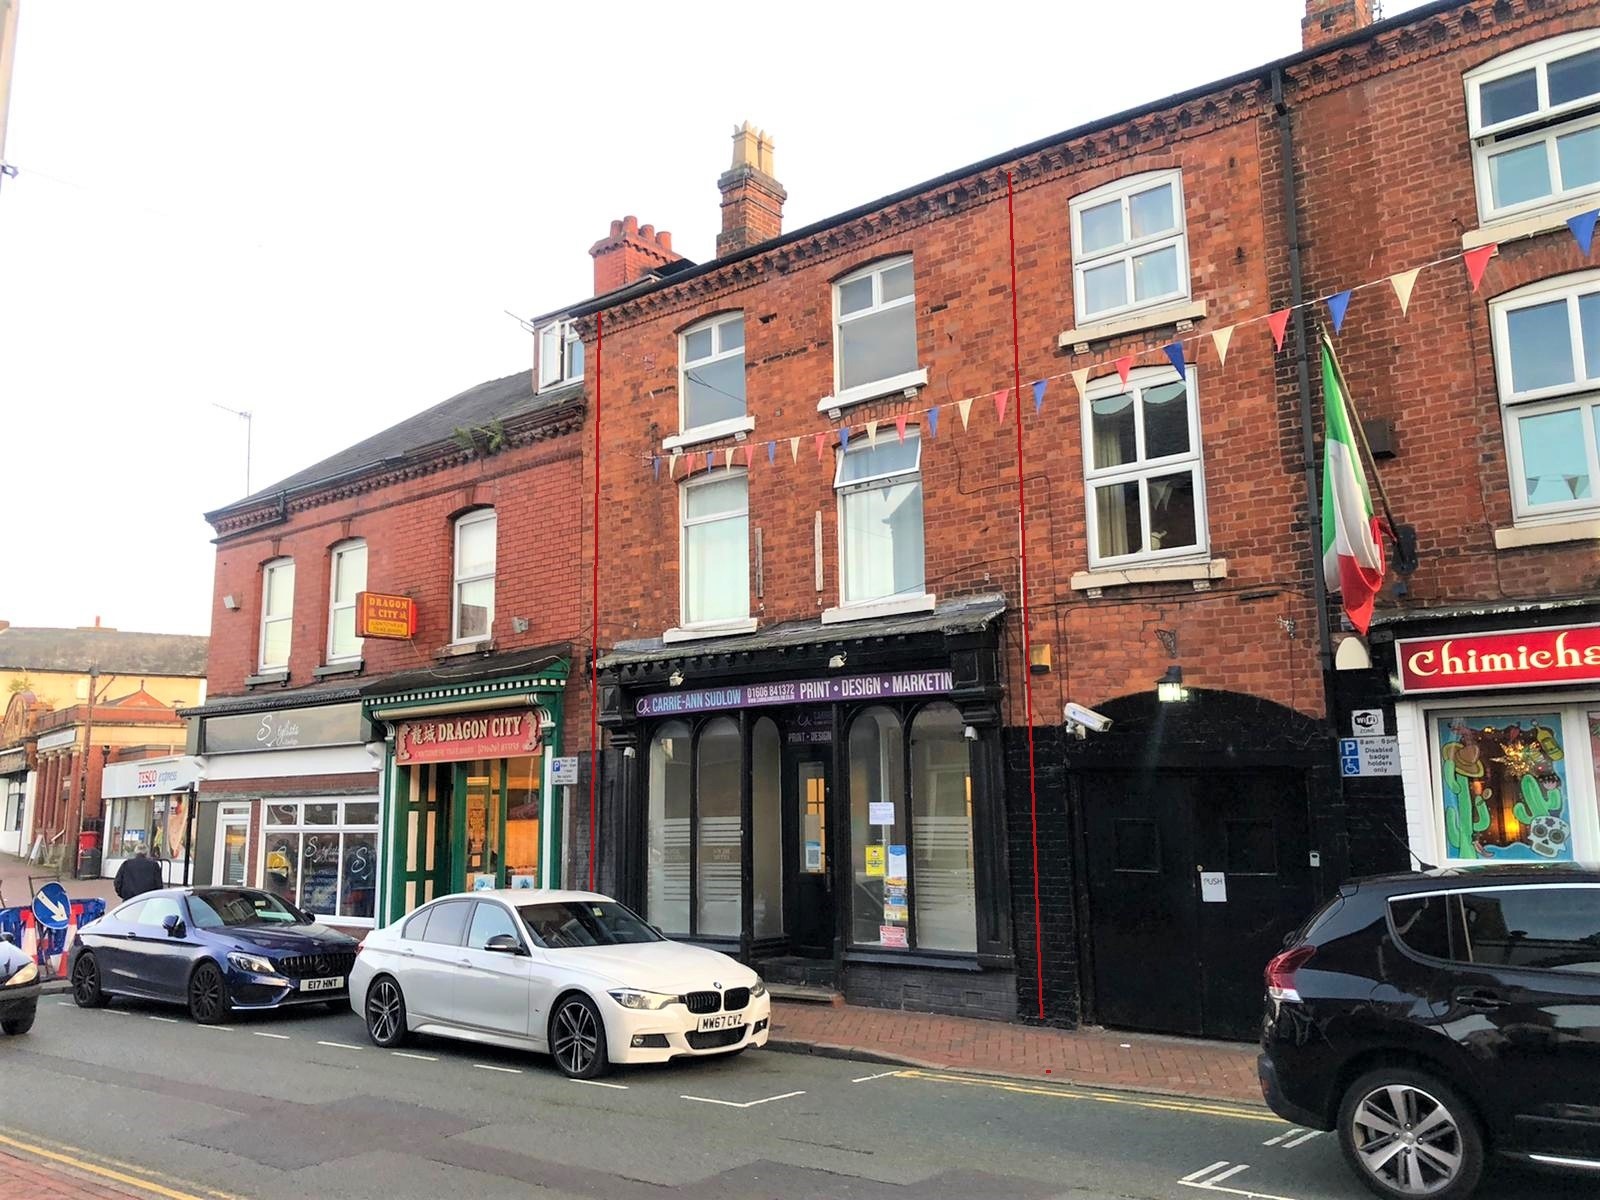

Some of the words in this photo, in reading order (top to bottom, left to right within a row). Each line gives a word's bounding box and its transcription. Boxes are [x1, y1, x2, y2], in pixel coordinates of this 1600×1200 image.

[368, 597, 408, 609] DRAGON
[378, 609, 399, 618] CITY
[747, 686, 768, 698] 01606
[769, 683, 795, 697] 841372
[800, 680, 831, 699] PRINT
[841, 677, 881, 697] DESIGN
[652, 692, 703, 712] CARRIE-ANN
[704, 689, 742, 706] SUDLOW
[438, 719, 488, 741] DRAGON
[491, 716, 522, 737] CITY
[1344, 742, 1356, 755] P
[139, 770, 157, 783] TESCO
[1203, 878, 1223, 886] PUSH
[308, 980, 321, 989] E17
[323, 979, 338, 987] HNT
[702, 1016, 726, 1029] MW67
[727, 1014, 743, 1026] CVZ
